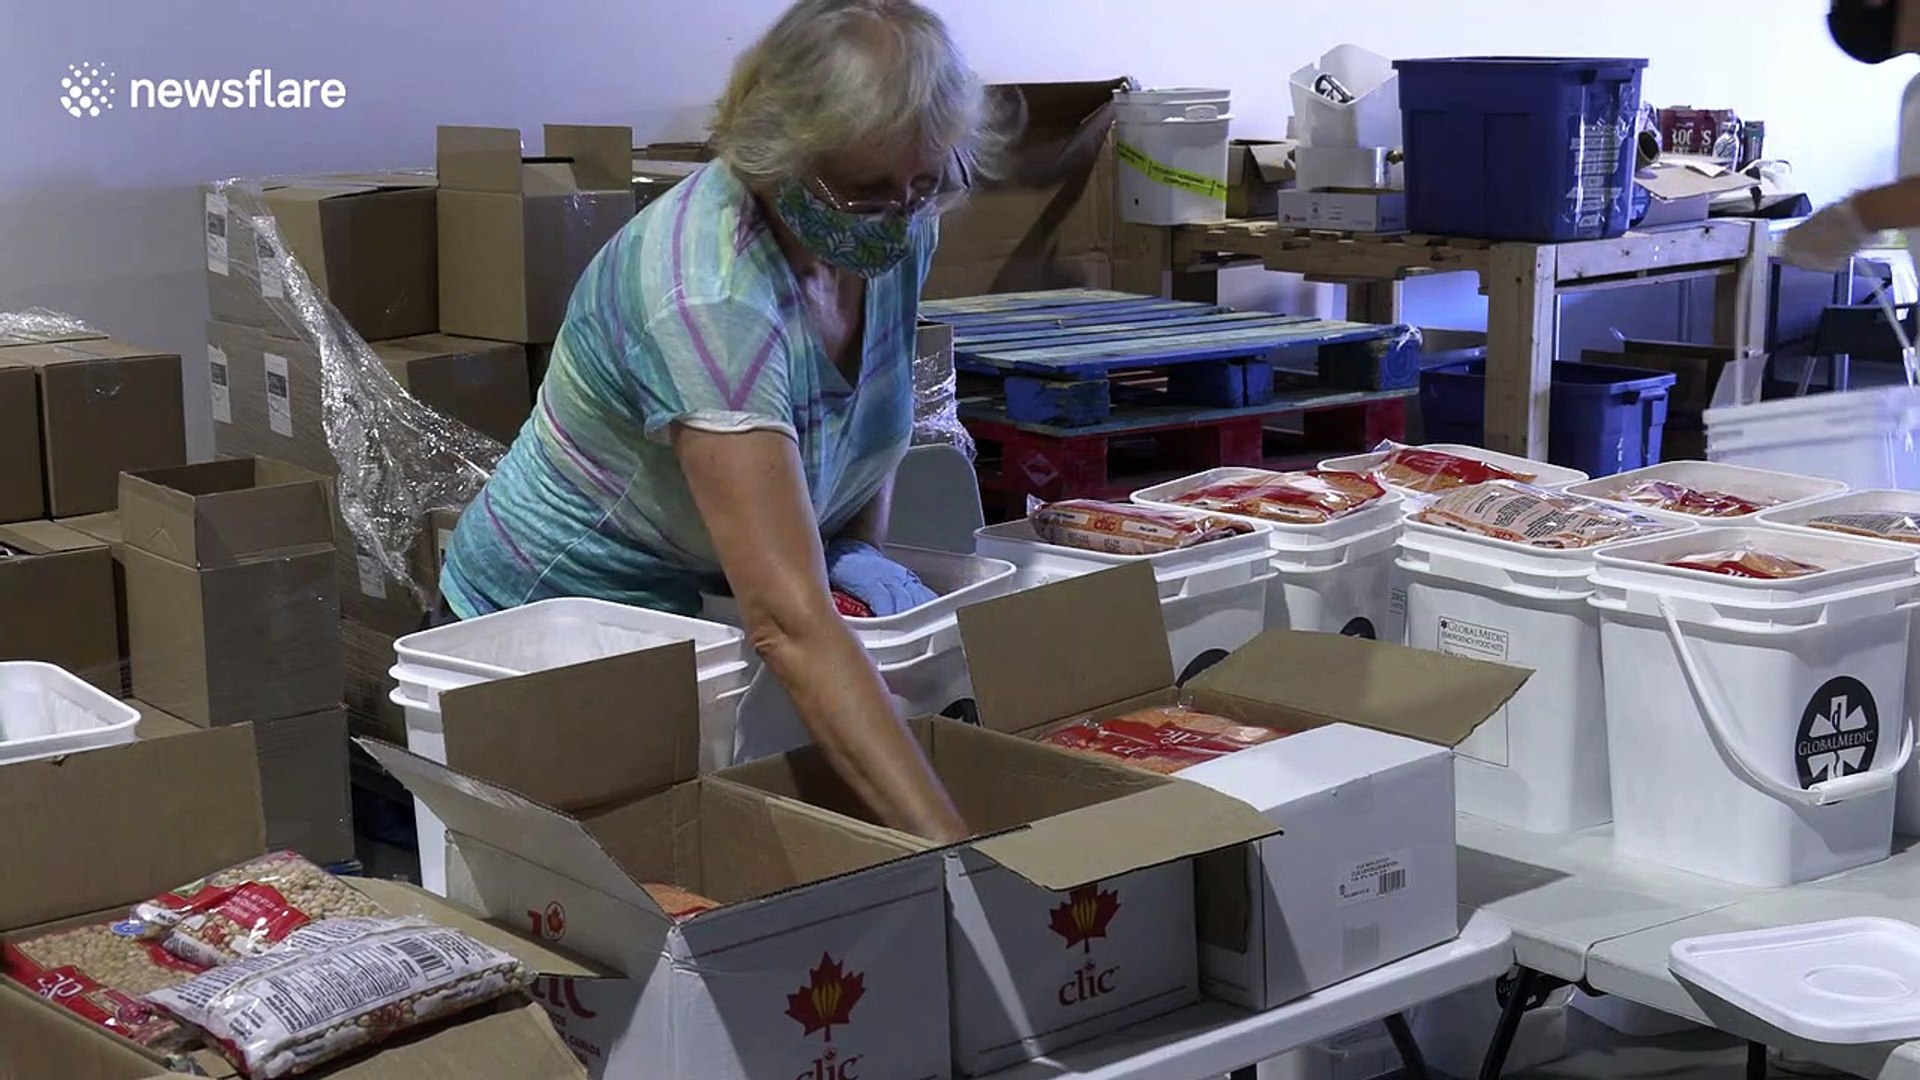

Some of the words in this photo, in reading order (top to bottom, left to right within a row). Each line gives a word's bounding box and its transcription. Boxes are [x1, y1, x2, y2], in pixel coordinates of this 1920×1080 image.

[1093, 516, 1116, 532] clic
[1447, 620, 1506, 643] GLOBALMEDIC
[1799, 731, 1874, 755] GLOBALMEDIC
[1058, 961, 1117, 1006] clic
